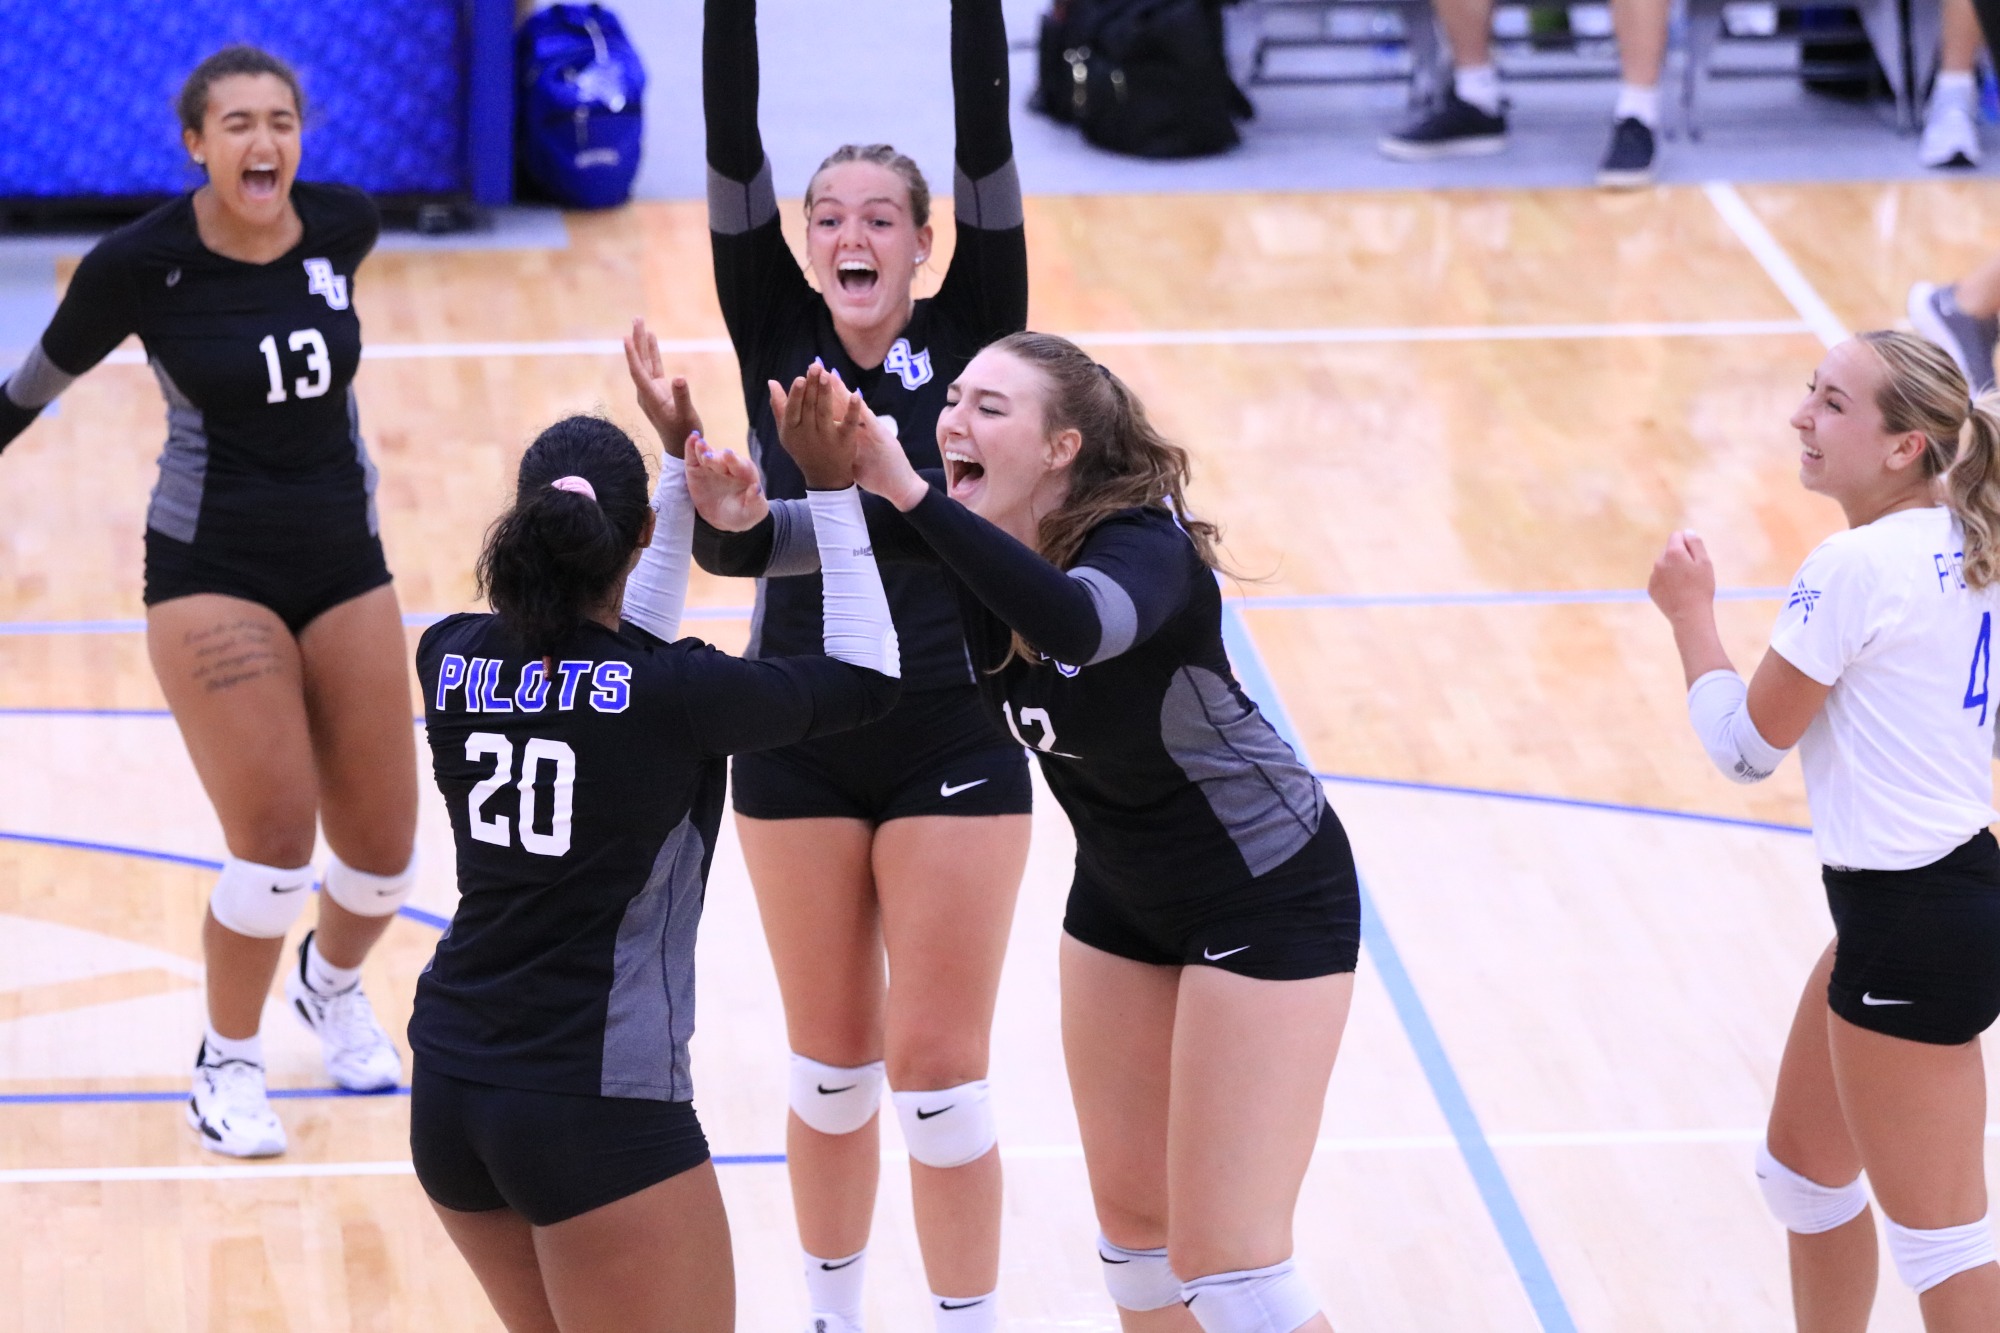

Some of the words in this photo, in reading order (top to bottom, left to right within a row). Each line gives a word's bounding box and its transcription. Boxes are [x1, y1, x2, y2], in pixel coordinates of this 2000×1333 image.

[303, 257, 349, 310] BU
[259, 328, 332, 404] 13
[883, 337, 934, 391] BU
[436, 653, 633, 713] PILOTS
[1963, 611, 1991, 727] 4
[1003, 700, 1083, 759] 12
[465, 732, 576, 857] 20
